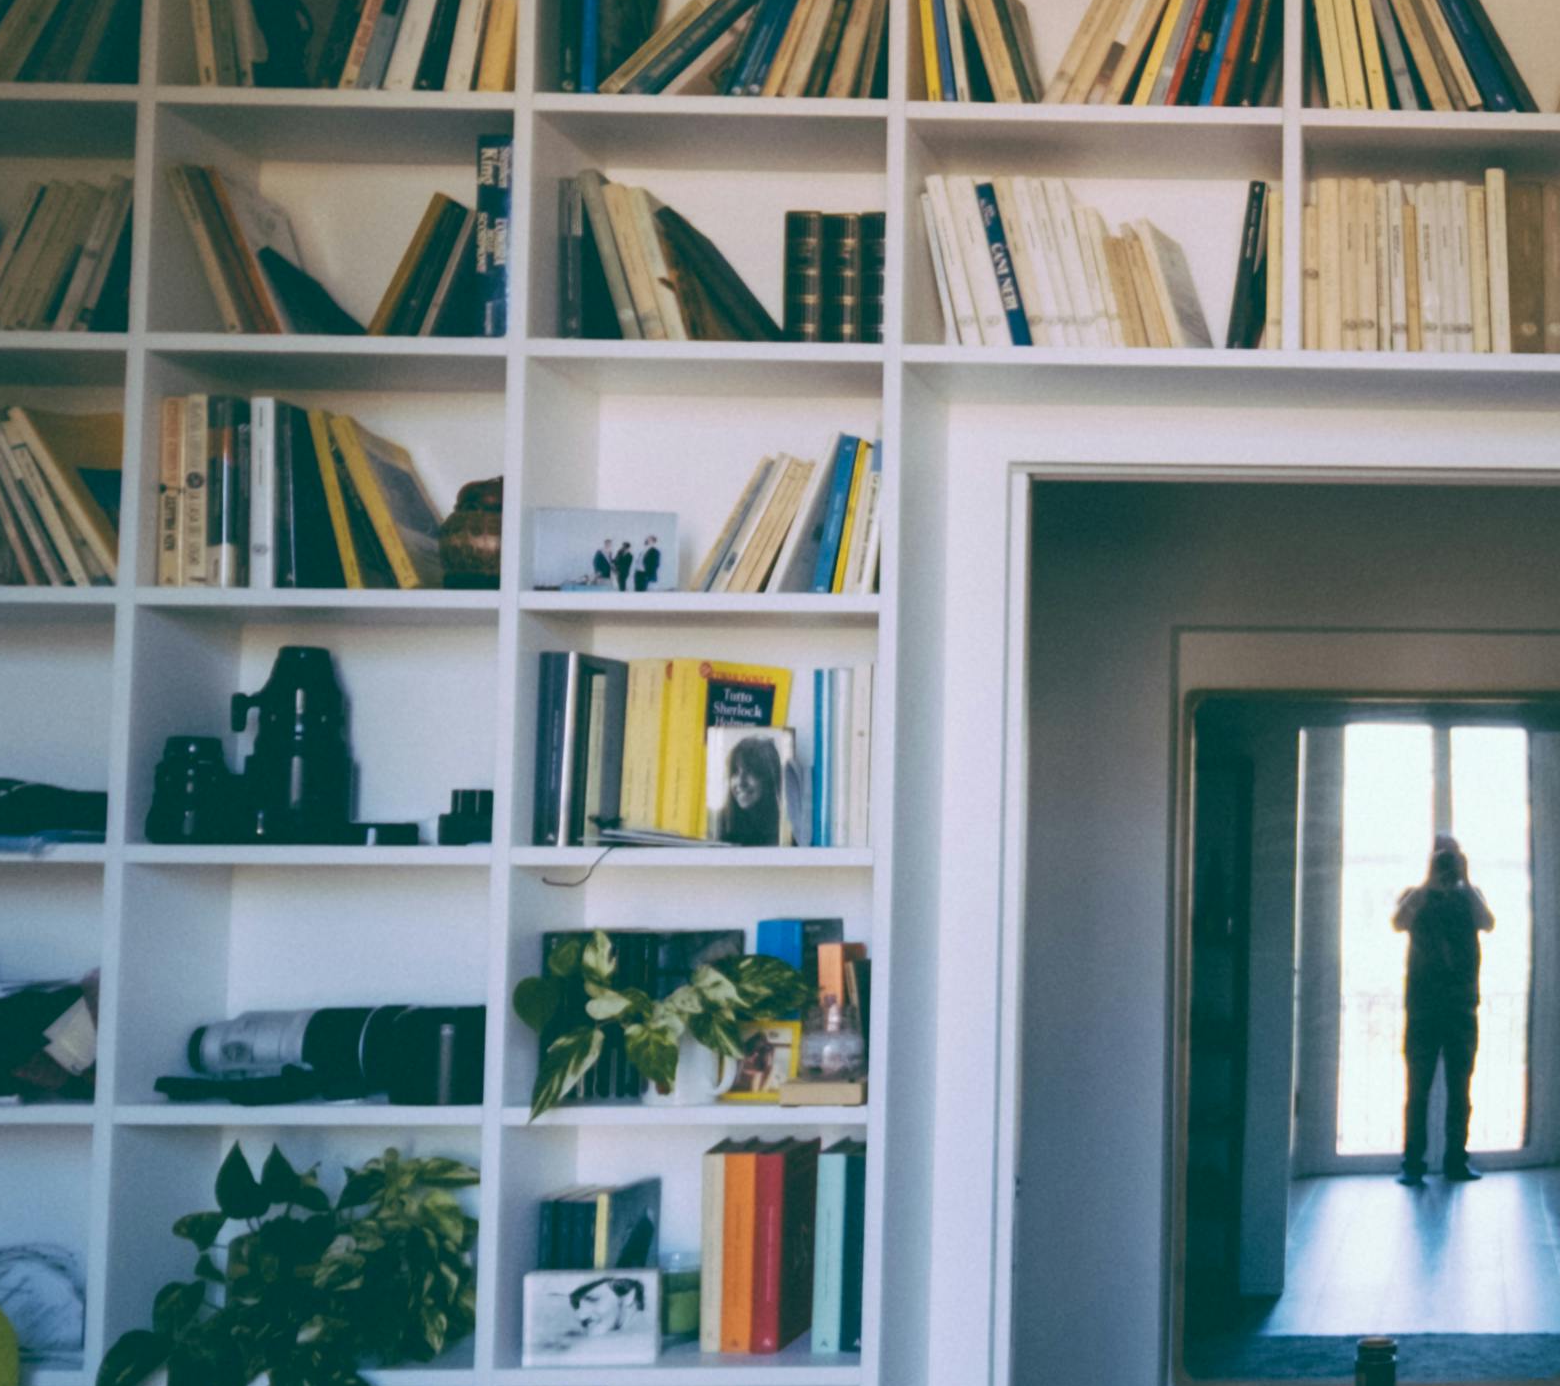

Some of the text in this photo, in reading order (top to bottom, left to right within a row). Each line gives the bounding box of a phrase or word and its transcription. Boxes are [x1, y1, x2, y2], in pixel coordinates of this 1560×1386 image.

[480, 147, 500, 186] King
[989, 242, 1011, 277] CANI
[996, 277, 1020, 312] NERI
[712, 701, 763, 720] Sherlock
[723, 688, 753, 705] Tutto
